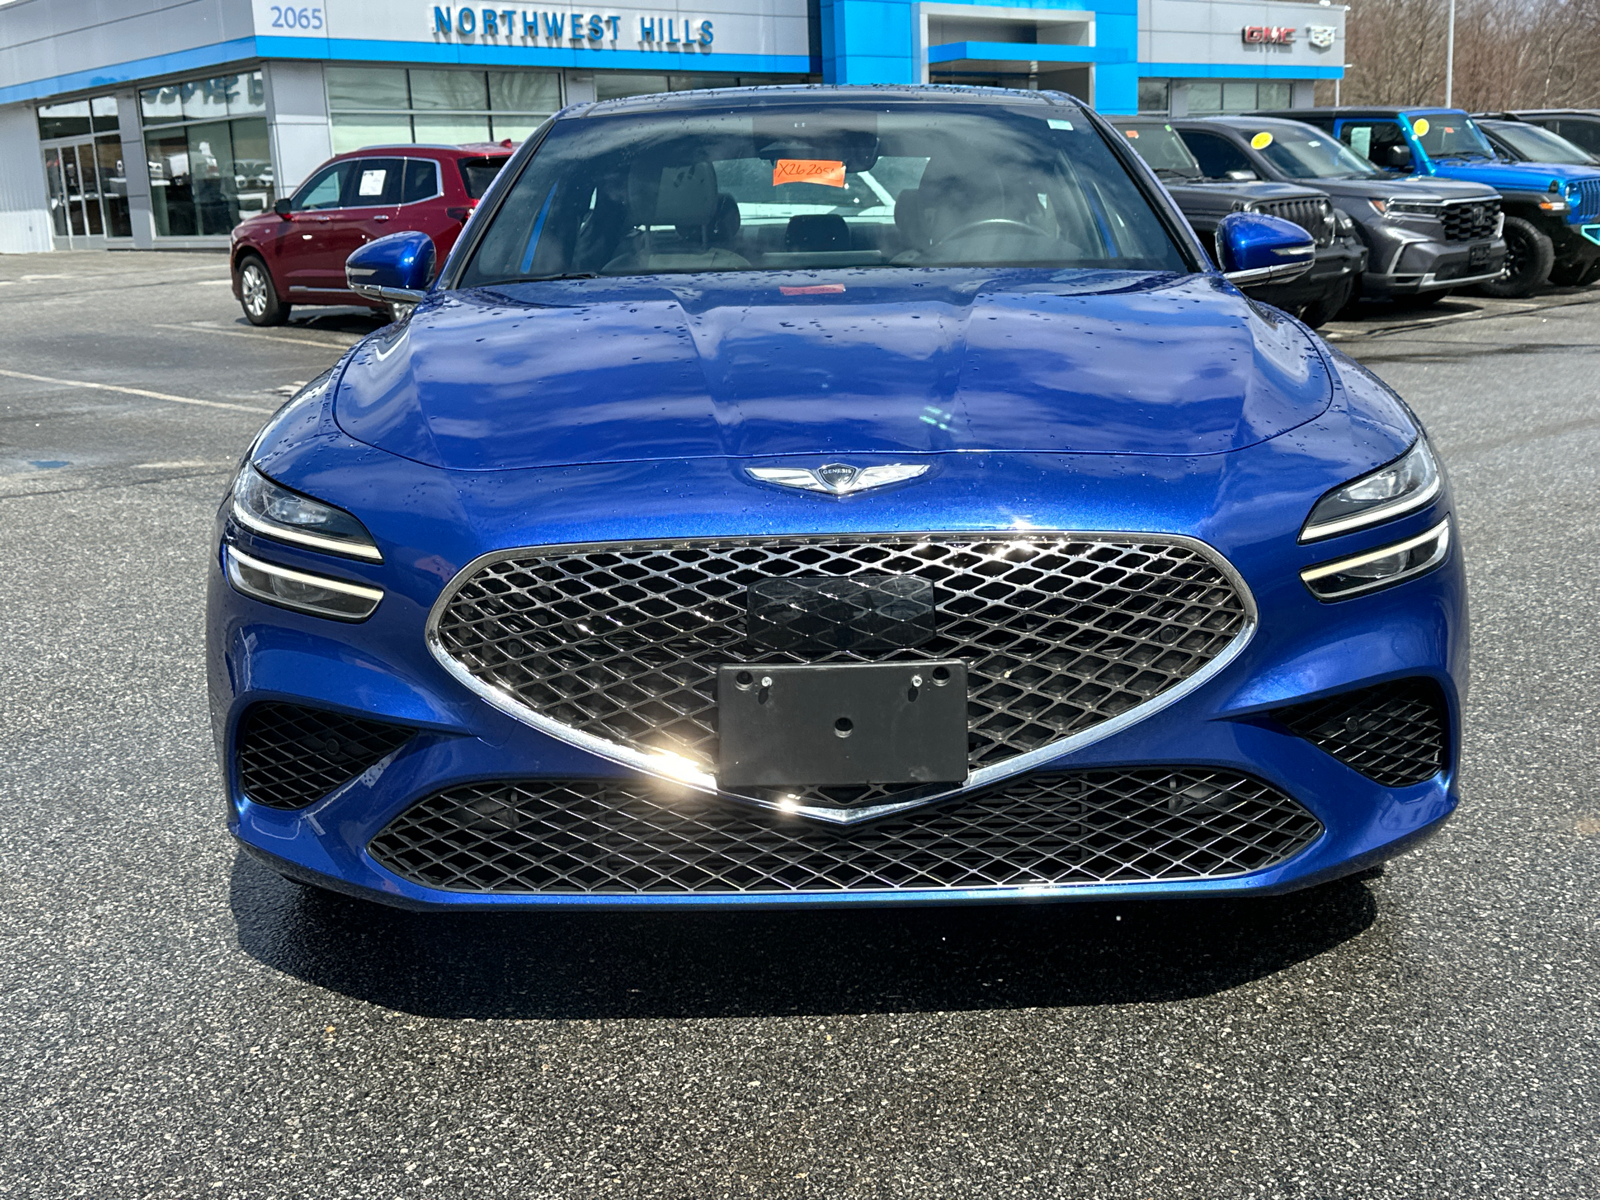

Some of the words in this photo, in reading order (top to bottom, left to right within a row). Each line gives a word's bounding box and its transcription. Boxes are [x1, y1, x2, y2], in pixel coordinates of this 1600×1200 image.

[270, 6, 323, 29] 2065
[433, 6, 621, 41] NORTHWEST
[640, 17, 714, 45] HILLS
[1242, 26, 1296, 44] GMC
